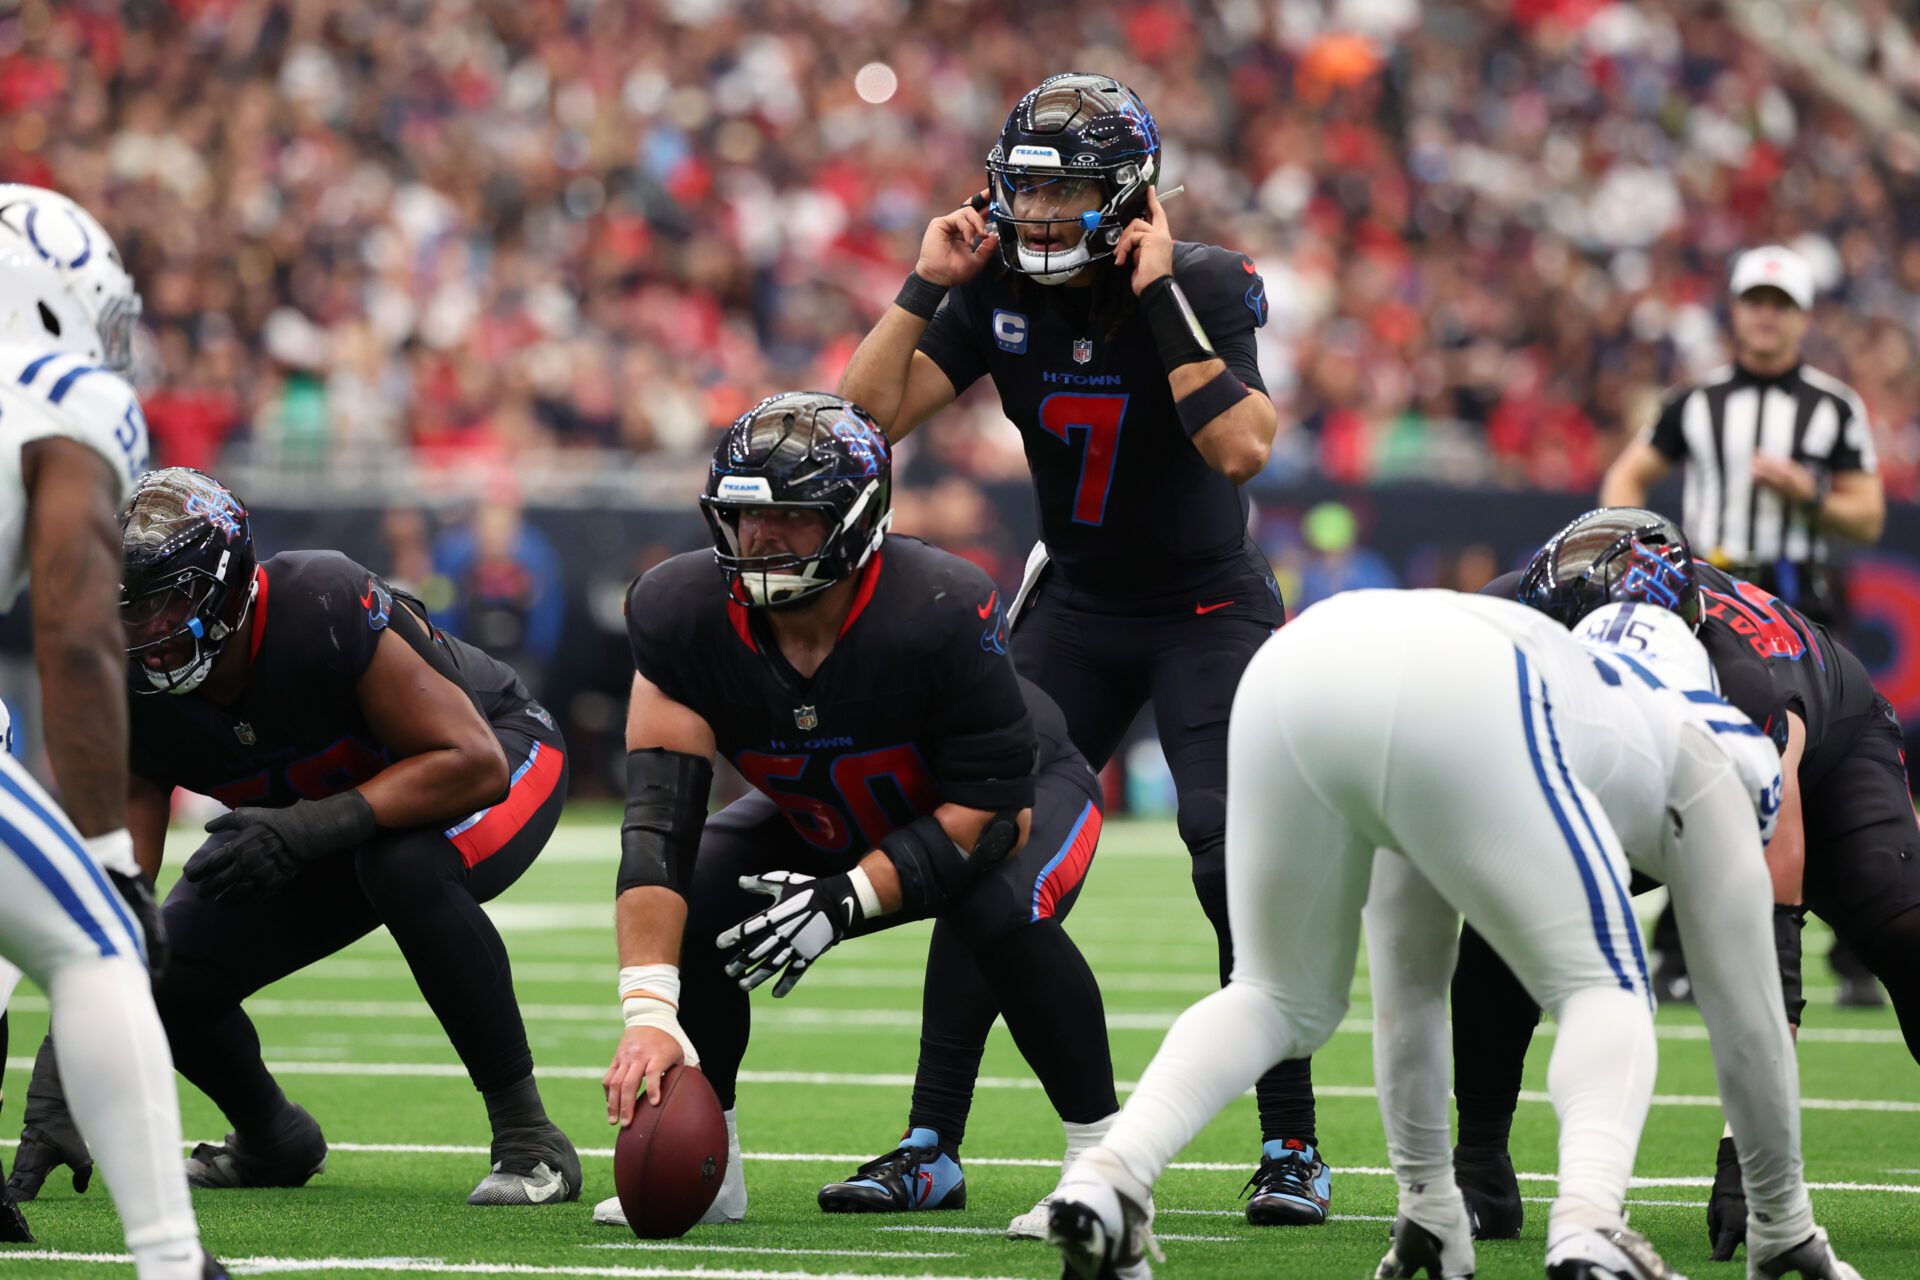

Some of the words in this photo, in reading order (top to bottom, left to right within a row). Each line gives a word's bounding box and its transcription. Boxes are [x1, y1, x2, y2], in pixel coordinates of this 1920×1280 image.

[994, 313, 1025, 343] C
[1042, 371, 1121, 385] H-TOWN
[1038, 391, 1130, 527] 7
[770, 736, 854, 749] HOWN
